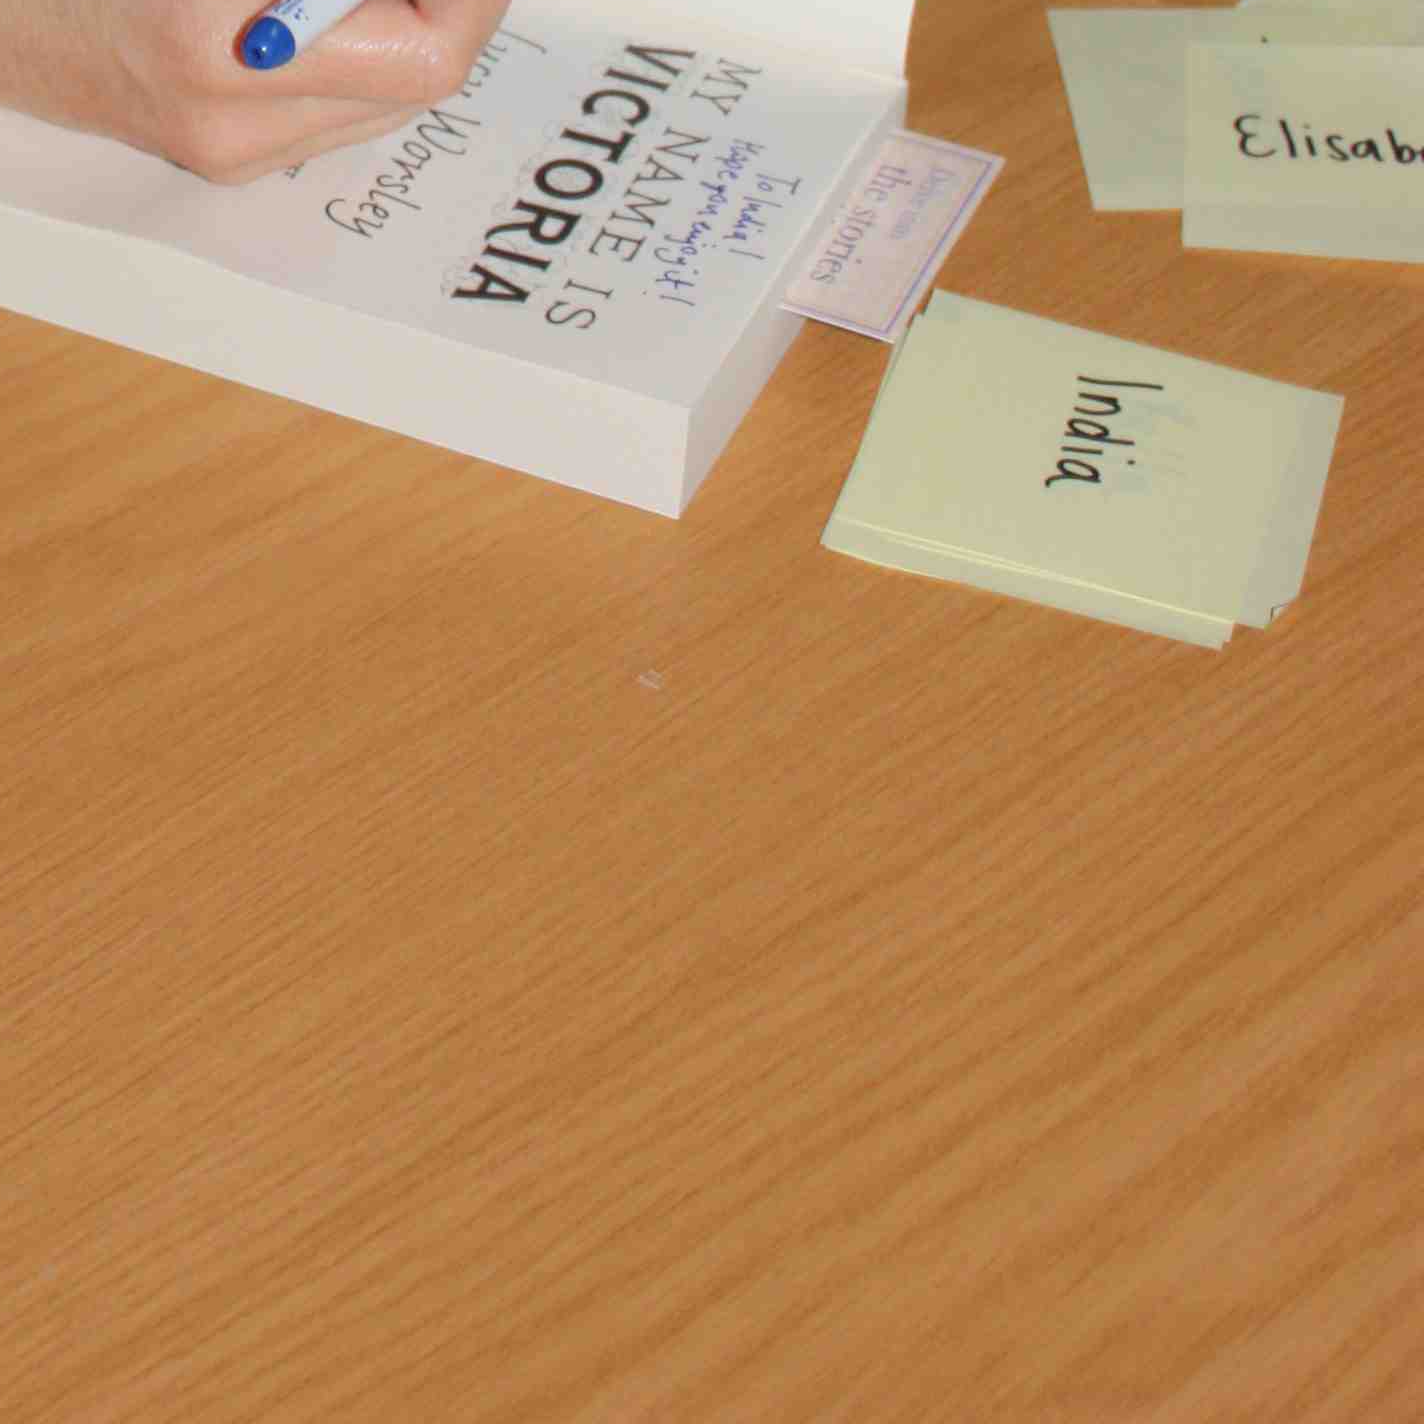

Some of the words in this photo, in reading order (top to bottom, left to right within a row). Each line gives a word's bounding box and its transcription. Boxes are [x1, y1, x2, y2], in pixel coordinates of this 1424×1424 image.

[689, 58, 762, 116] MY
[326, 108, 481, 239] Worsley
[451, 44, 696, 303] VICTORIA
[1233, 114, 1424, 164] Elisab
[589, 127, 712, 262] NAME
[865, 164, 912, 201] the
[810, 206, 875, 284] stories
[546, 279, 613, 330] IS
[1044, 376, 1164, 489] India
